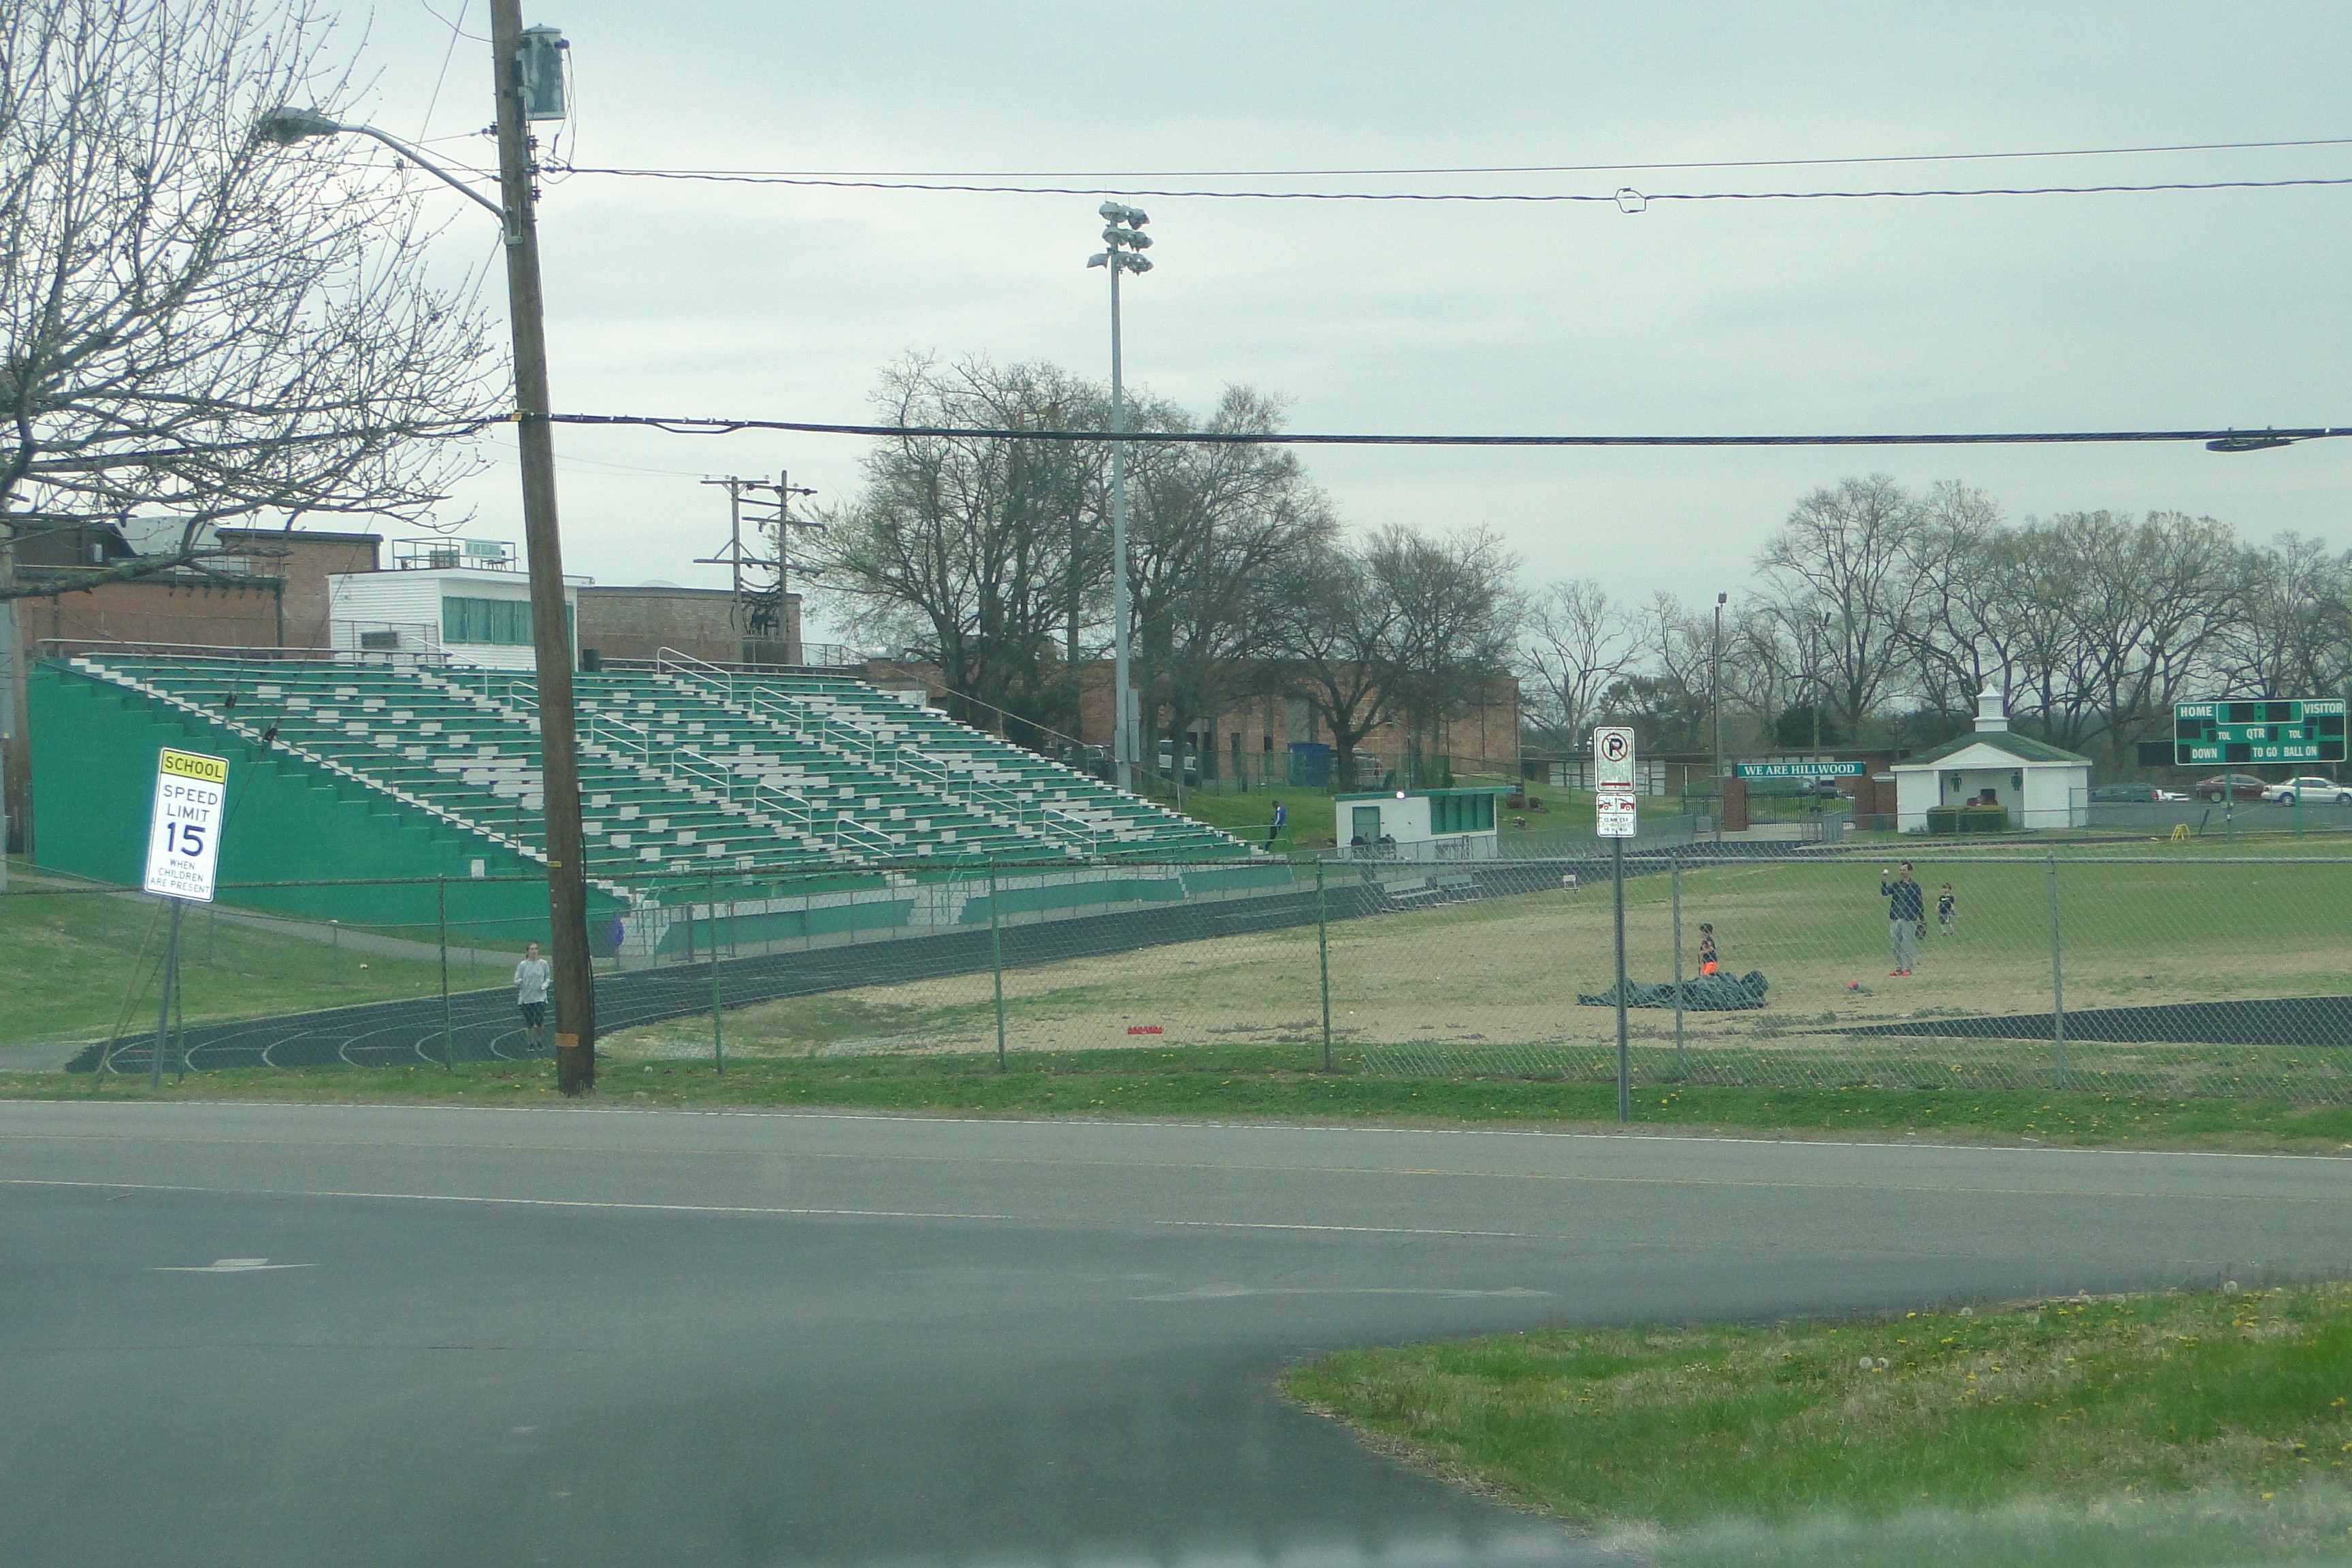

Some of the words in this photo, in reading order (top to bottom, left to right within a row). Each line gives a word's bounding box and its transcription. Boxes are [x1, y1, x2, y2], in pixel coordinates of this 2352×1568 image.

[2180, 706, 2212, 717] HOME
[2304, 703, 2343, 715] VISITOR
[2218, 732, 2232, 740] TOL
[2246, 728, 2265, 740] QTR
[2288, 730, 2302, 739] TOL
[2192, 748, 2217, 760] DOWN
[2253, 747, 2264, 757] TO
[2266, 747, 2278, 757] GO
[2283, 746, 2304, 757] BALL
[2305, 746, 2317, 757] ON
[165, 756, 223, 779] SCHOOL
[1744, 766, 1763, 776] WE
[1765, 765, 1788, 775] ARE
[1791, 764, 1855, 774] HILLWOOD
[163, 785, 218, 805] SPEED
[167, 803, 210, 823] LIMIT
[167, 821, 206, 858] 15
[170, 858, 195, 870] WHEN
[159, 868, 203, 883] CHILDREN
[150, 877, 167, 887] ARE
[170, 880, 210, 895] PRESENT
